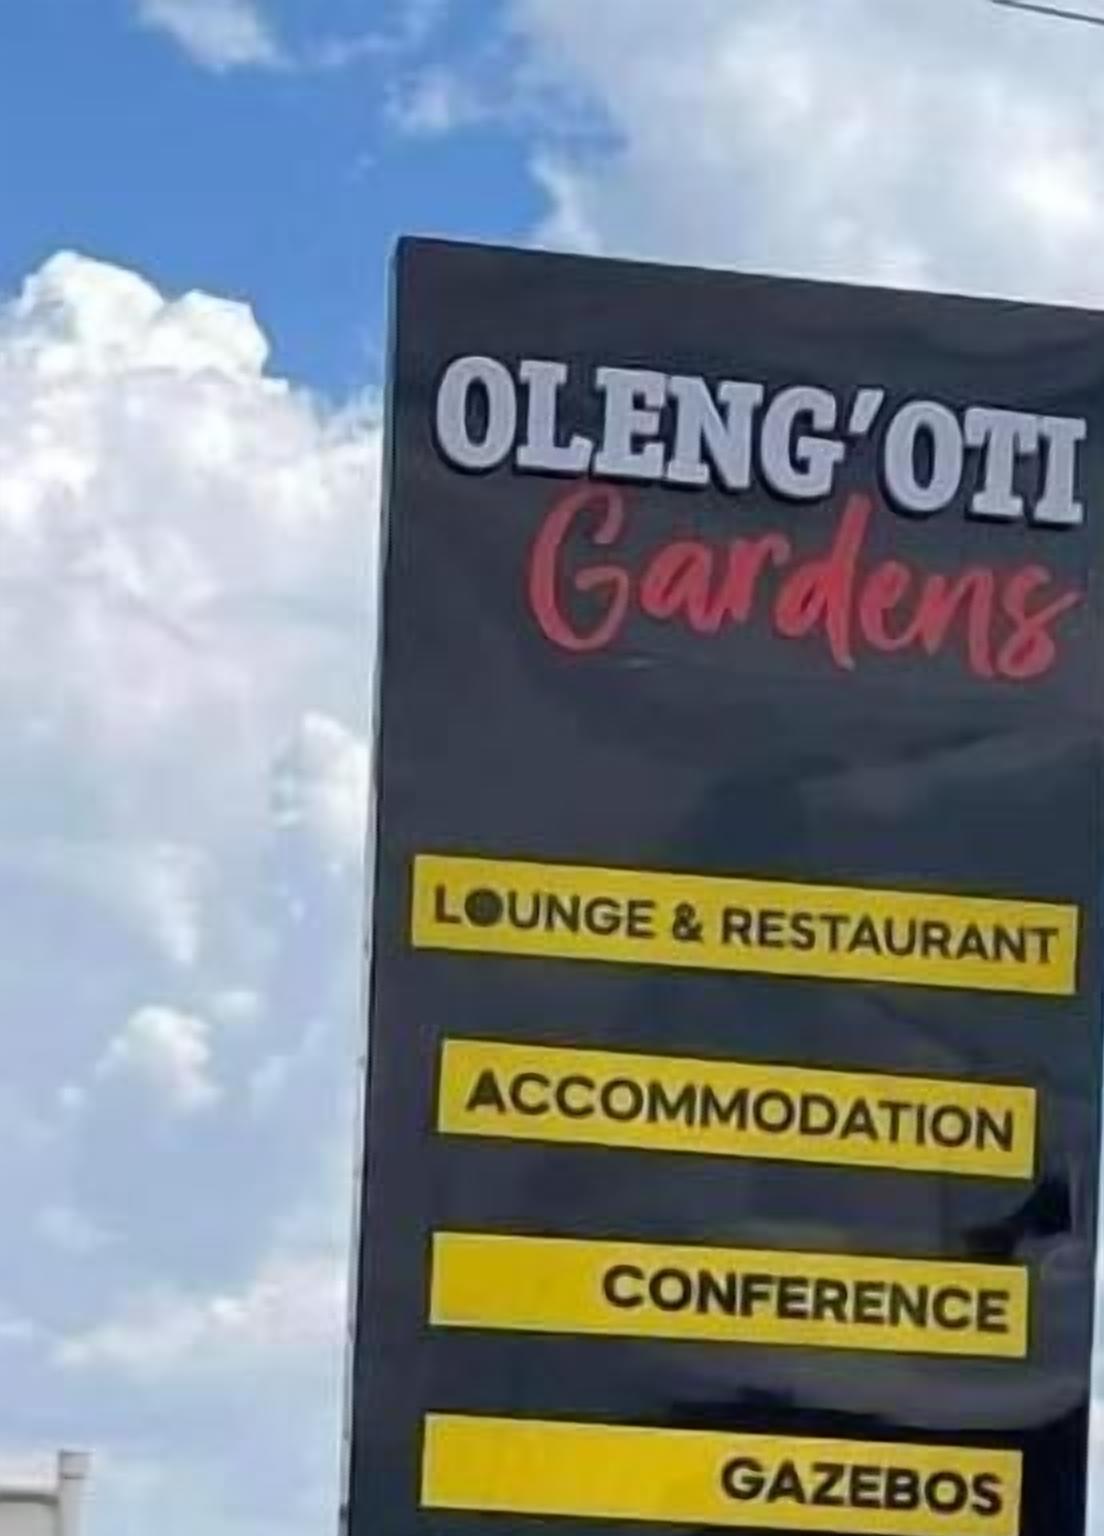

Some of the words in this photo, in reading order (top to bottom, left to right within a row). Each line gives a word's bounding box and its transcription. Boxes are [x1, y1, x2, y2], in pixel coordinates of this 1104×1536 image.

[435, 356, 1087, 527] OLENG'OTI
[527, 489, 1086, 679] Gardens
[434, 884, 655, 940] LOUNGE
[671, 903, 705, 945] &
[722, 907, 1059, 965] RESTAURANT
[466, 1069, 1014, 1152] ACCOMMODATION
[602, 1264, 1010, 1333] CONFERENCE
[720, 1456, 1002, 1516] GAZEBOS
